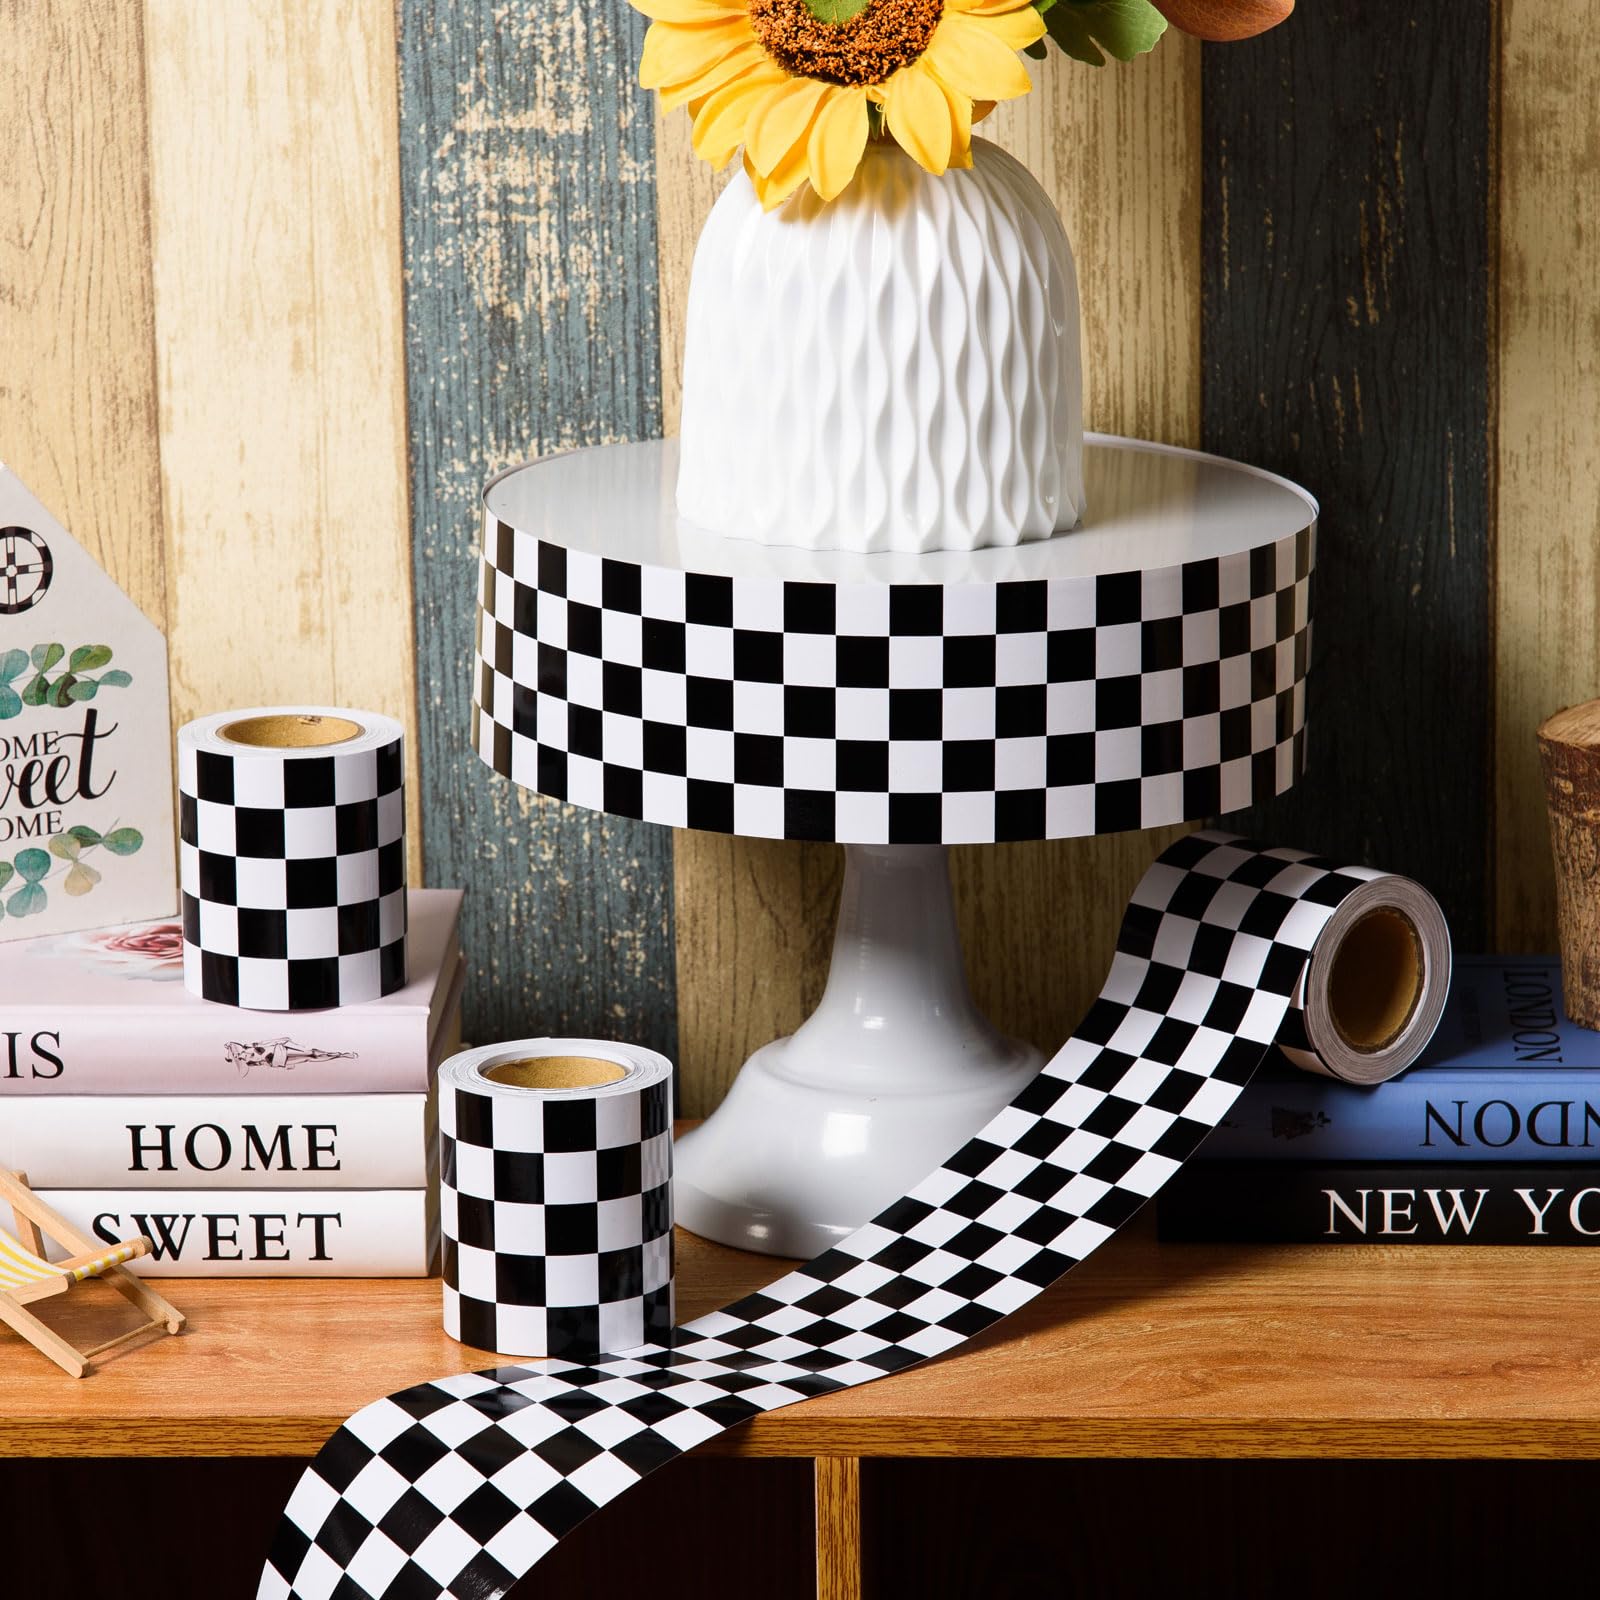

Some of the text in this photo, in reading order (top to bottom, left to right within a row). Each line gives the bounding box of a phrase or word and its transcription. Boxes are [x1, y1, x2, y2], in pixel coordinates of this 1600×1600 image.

[1503, 970, 1563, 1063] LONDON
[125, 1123, 341, 1171] HOME
[1322, 1188, 1490, 1235] NEW
[92, 1212, 342, 1261] SWEET
